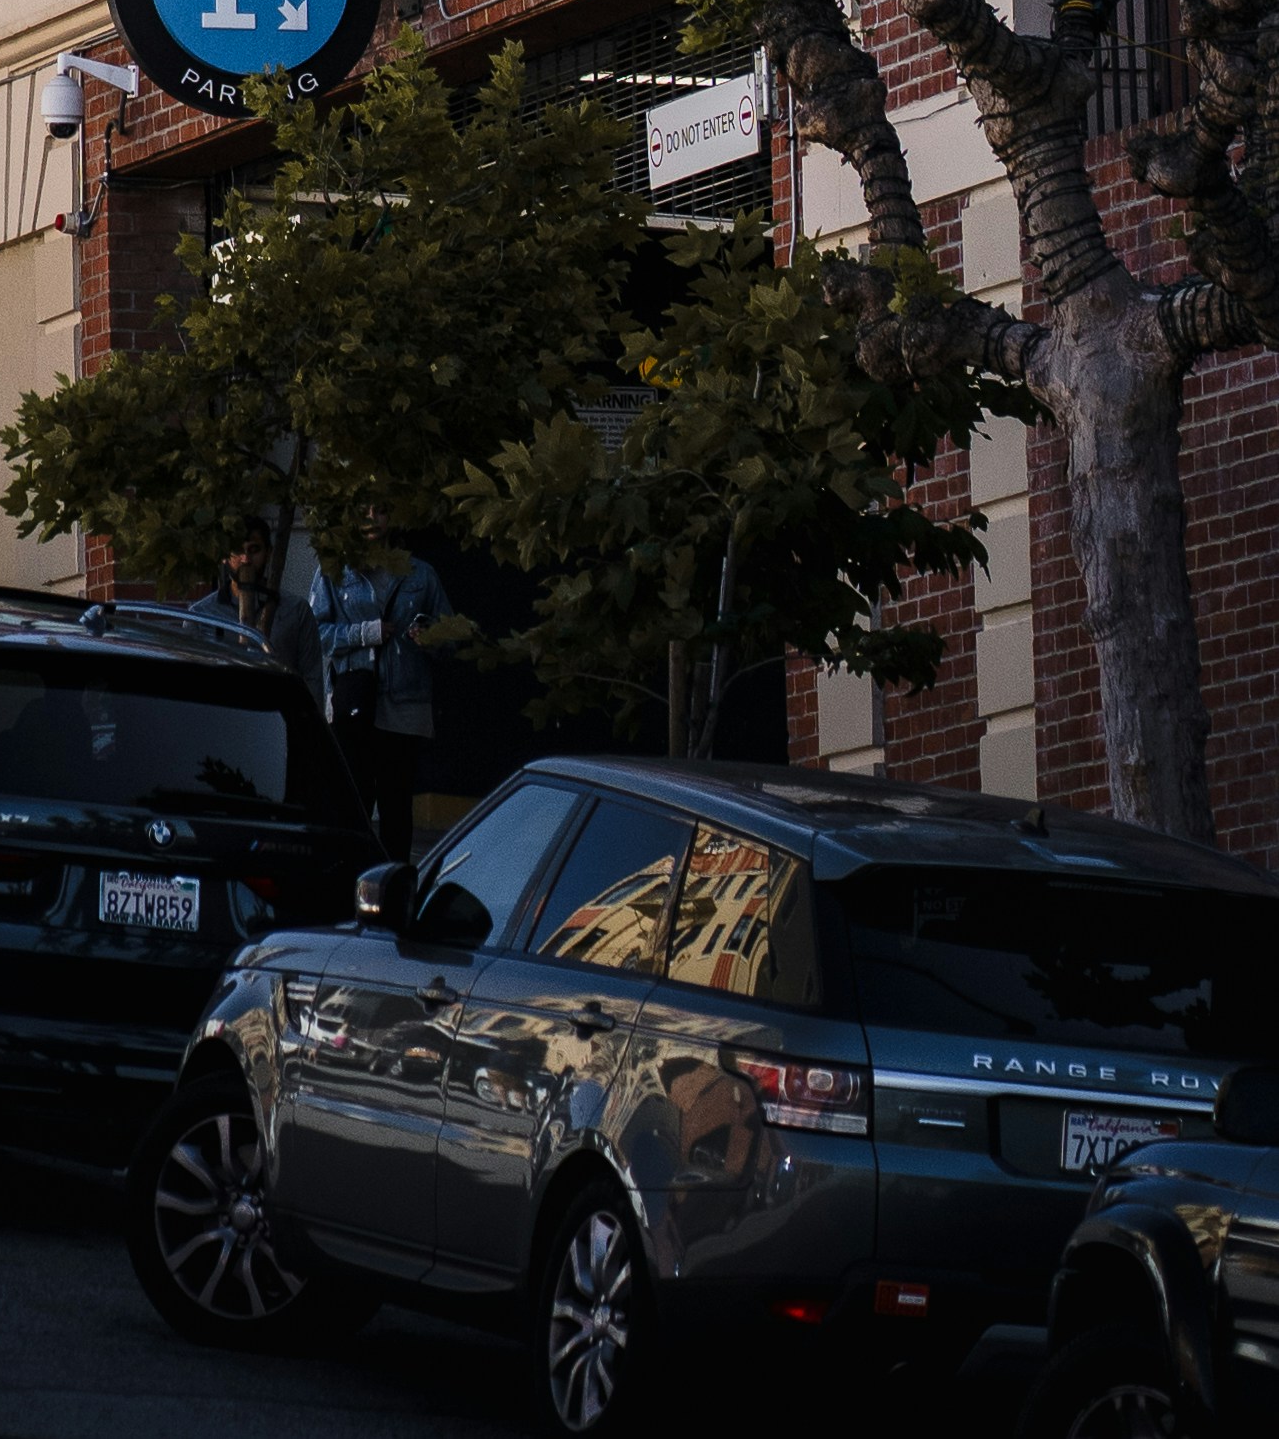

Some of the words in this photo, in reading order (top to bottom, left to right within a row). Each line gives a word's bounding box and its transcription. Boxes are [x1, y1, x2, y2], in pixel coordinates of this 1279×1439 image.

[180, 68, 319, 105] PARG
[666, 130, 680, 154] DO
[682, 122, 701, 149] NOT
[703, 111, 736, 140] ENTER
[973, 1054, 1117, 1082] RANGE
[1088, 1117, 1153, 1137] California
